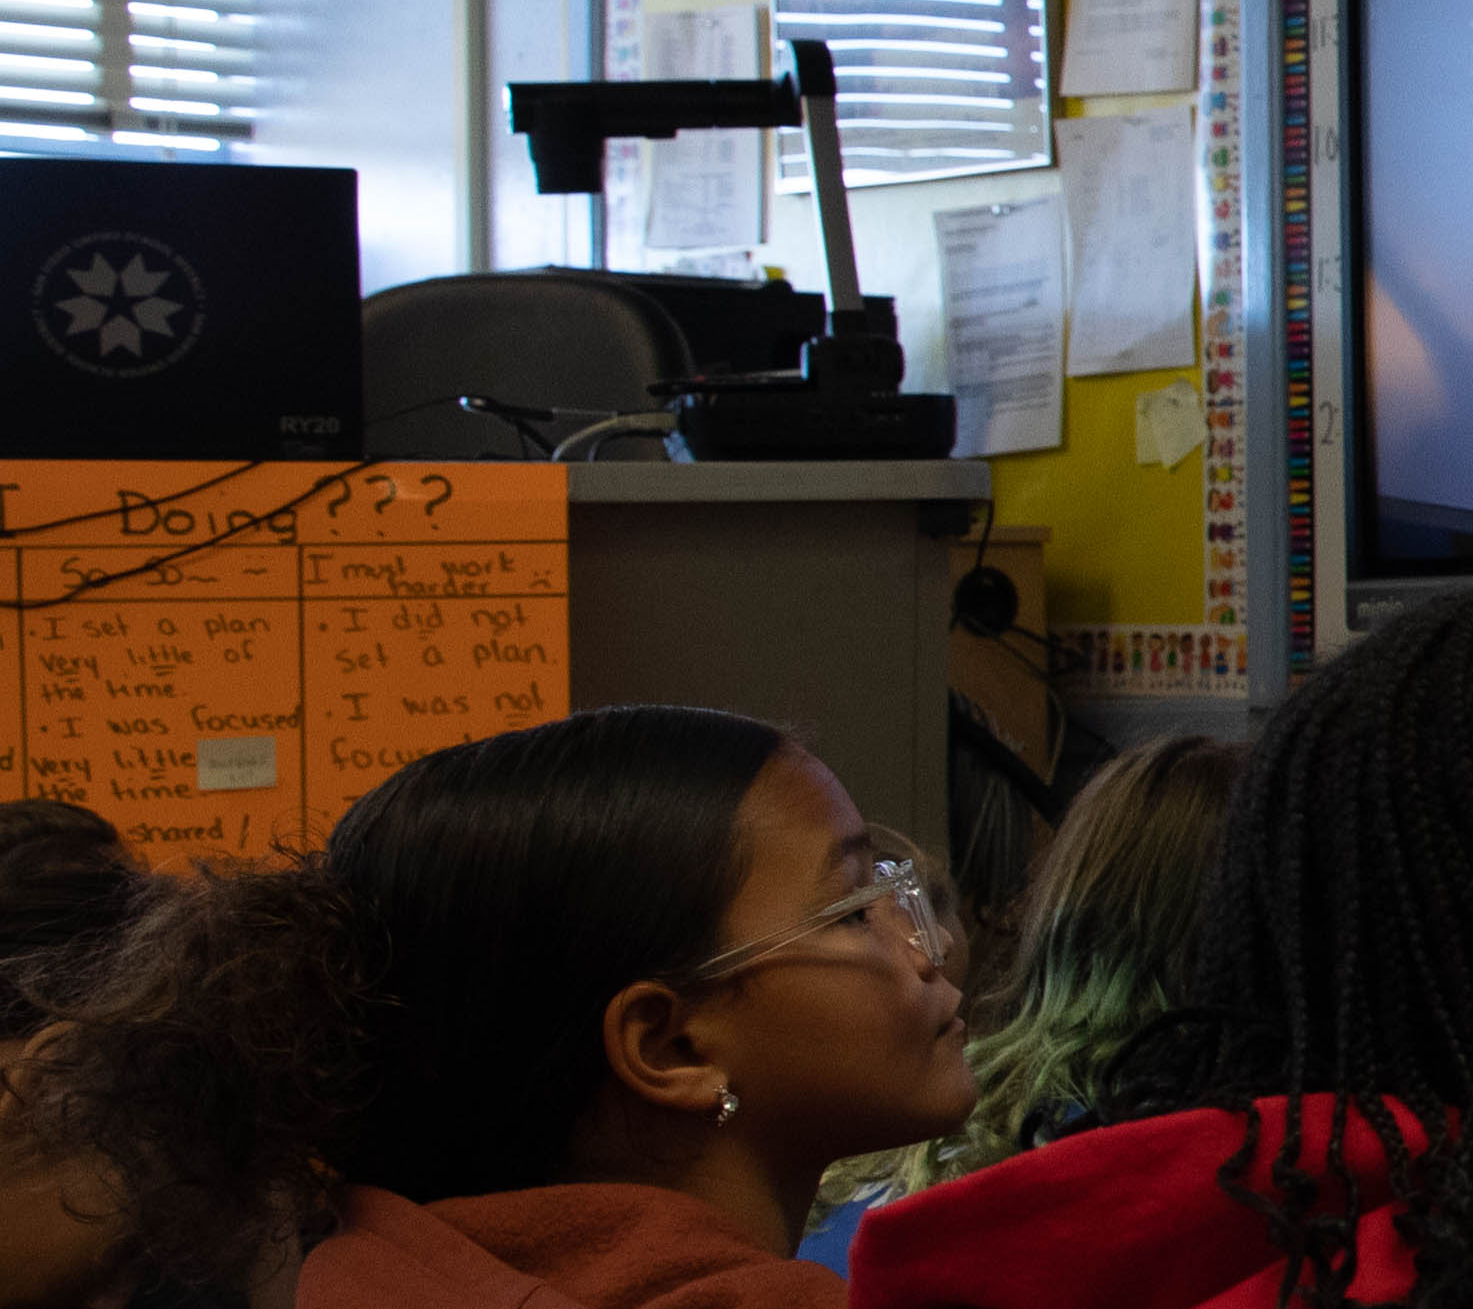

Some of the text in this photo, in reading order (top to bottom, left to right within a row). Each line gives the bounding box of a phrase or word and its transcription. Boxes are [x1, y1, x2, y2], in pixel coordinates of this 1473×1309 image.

[117, 490, 298, 545] Doing
[306, 554, 333, 584] I
[42, 612, 271, 640] I set a plan
[341, 602, 528, 633] I did not
[38, 651, 100, 681] very
[222, 639, 255, 665] of
[334, 641, 388, 674] set
[421, 645, 446, 667] a
[341, 679, 546, 721] I was not
[58, 716, 82, 740] I
[106, 716, 170, 737] was
[30, 756, 93, 782] very
